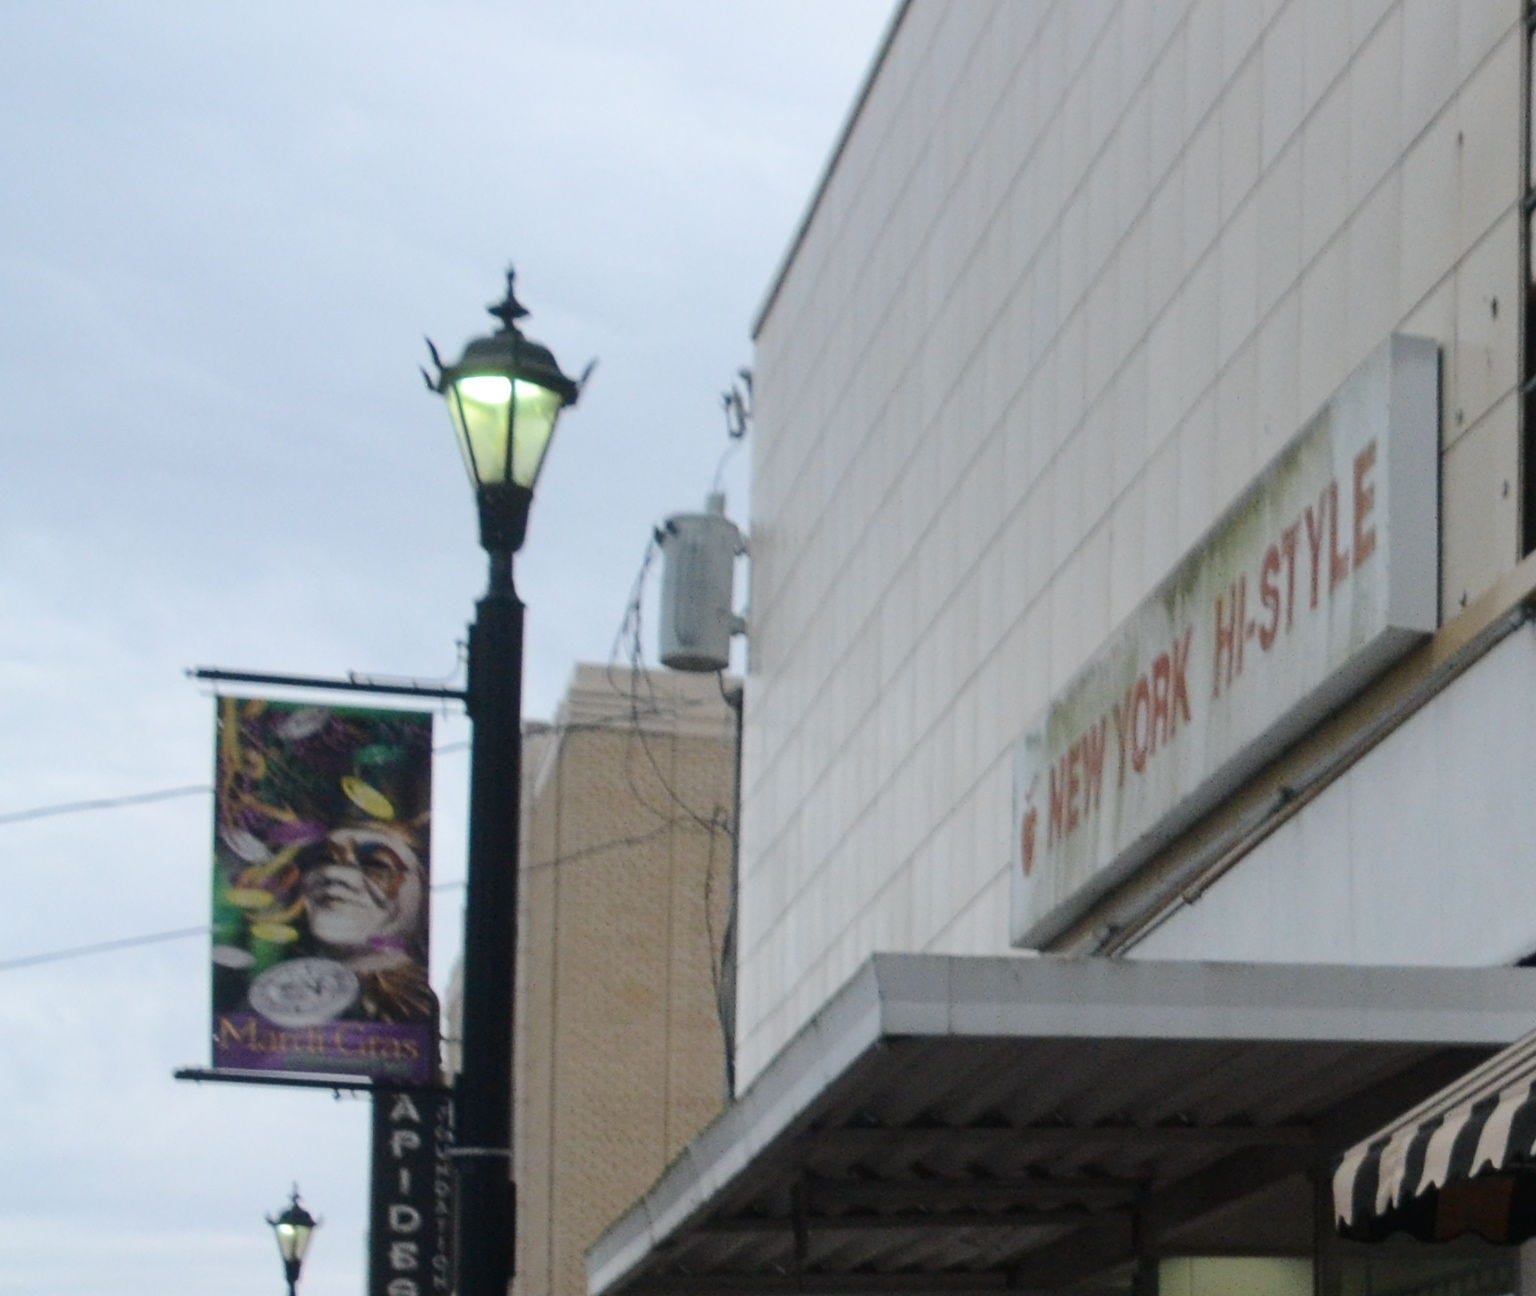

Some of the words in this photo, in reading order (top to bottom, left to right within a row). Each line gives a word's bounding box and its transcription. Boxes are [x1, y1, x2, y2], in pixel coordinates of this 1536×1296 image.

[1047, 718, 1106, 848] NEW
[1114, 625, 1192, 788] YORK
[1212, 436, 1378, 698] HI-STYLE
[218, 1017, 325, 1055] Mardi
[335, 1022, 420, 1058] Gras
